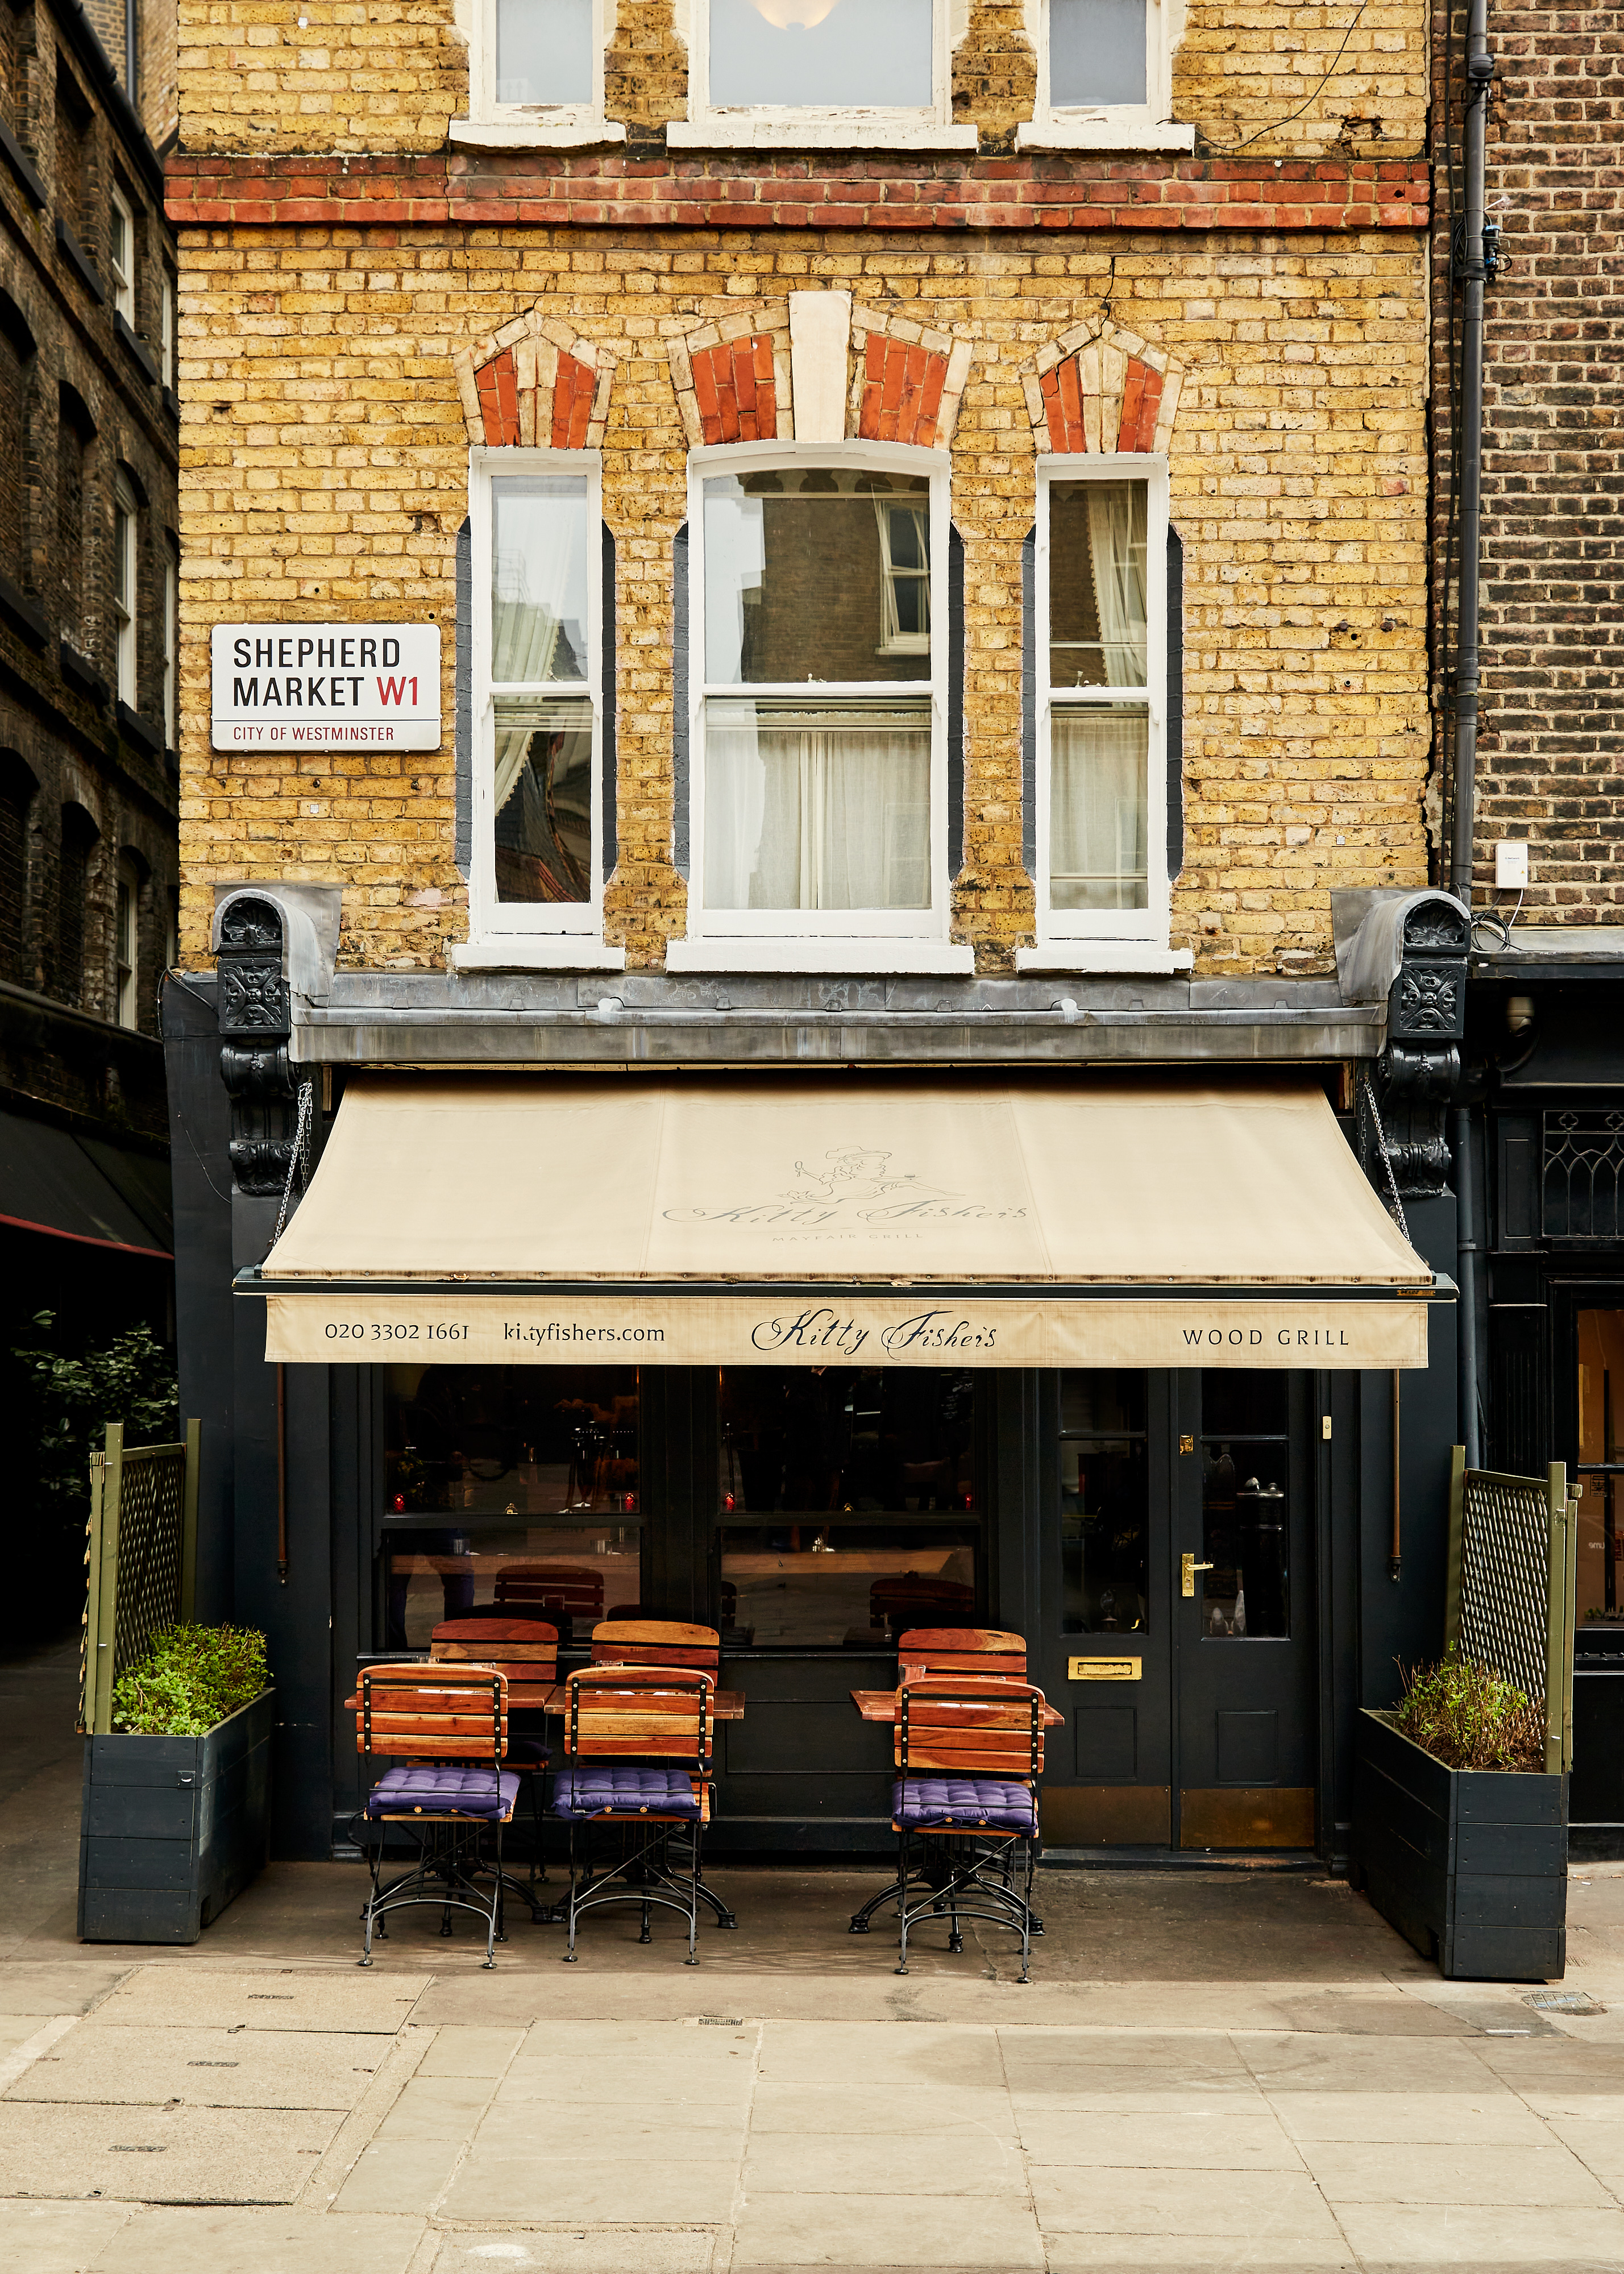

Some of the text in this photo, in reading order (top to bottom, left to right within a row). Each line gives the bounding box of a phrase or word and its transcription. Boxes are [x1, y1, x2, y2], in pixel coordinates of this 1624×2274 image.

[234, 638, 400, 668] SHEPHERD
[234, 676, 418, 706] MARKET W1
[234, 727, 393, 740] CITY OF WESTMINSTER
[662, 1205, 838, 1225] Kitty
[325, 1323, 470, 1341] 020 3302 1661
[751, 1308, 870, 1355] Kitty
[1182, 1329, 1349, 1345] WOOD GRILL
